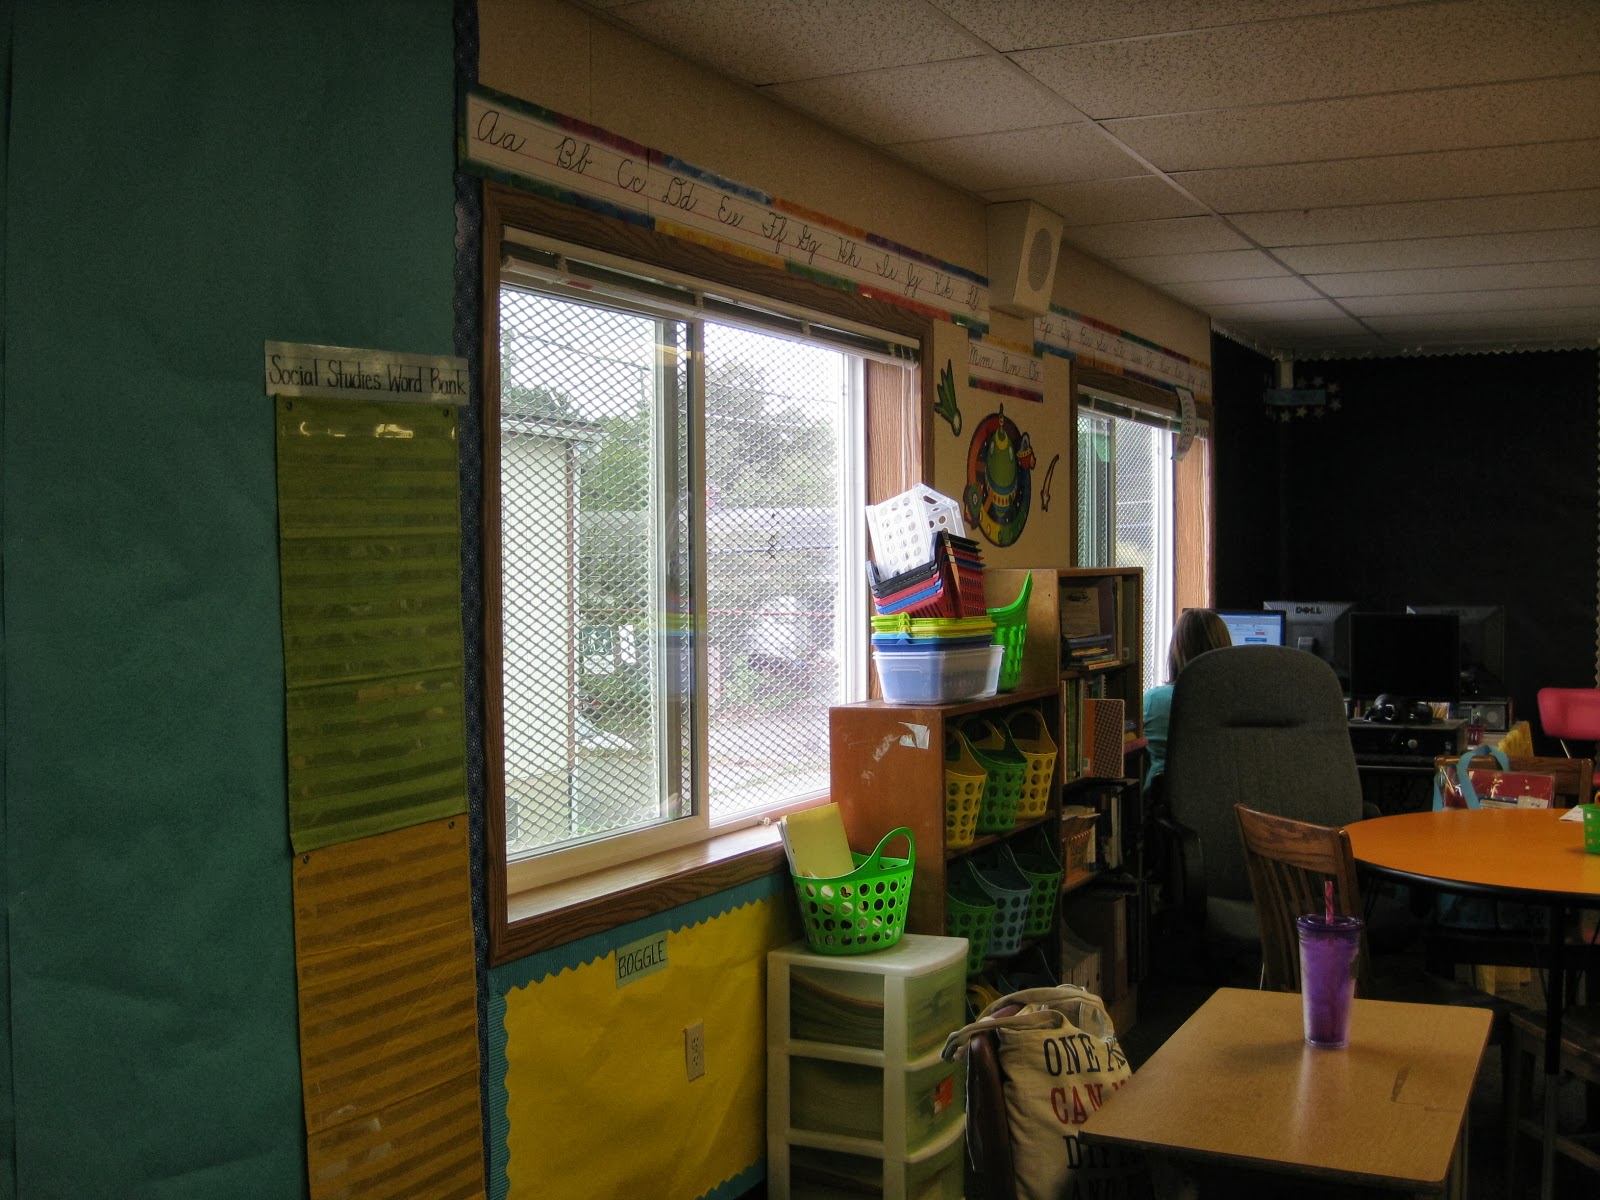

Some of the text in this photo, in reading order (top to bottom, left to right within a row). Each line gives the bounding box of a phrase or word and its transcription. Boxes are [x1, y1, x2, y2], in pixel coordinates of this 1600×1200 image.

[477, 110, 527, 152] Aa
[554, 136, 592, 175] Bb
[617, 158, 646, 193] Cc
[662, 177, 697, 211] Dd
[269, 354, 467, 395] Social Studies Word Bank
[1295, 606, 1322, 614] DELL
[618, 940, 666, 979] BOGGLE
[1043, 1033, 1101, 1076] ONE
[1050, 1083, 1103, 1124] CAN
